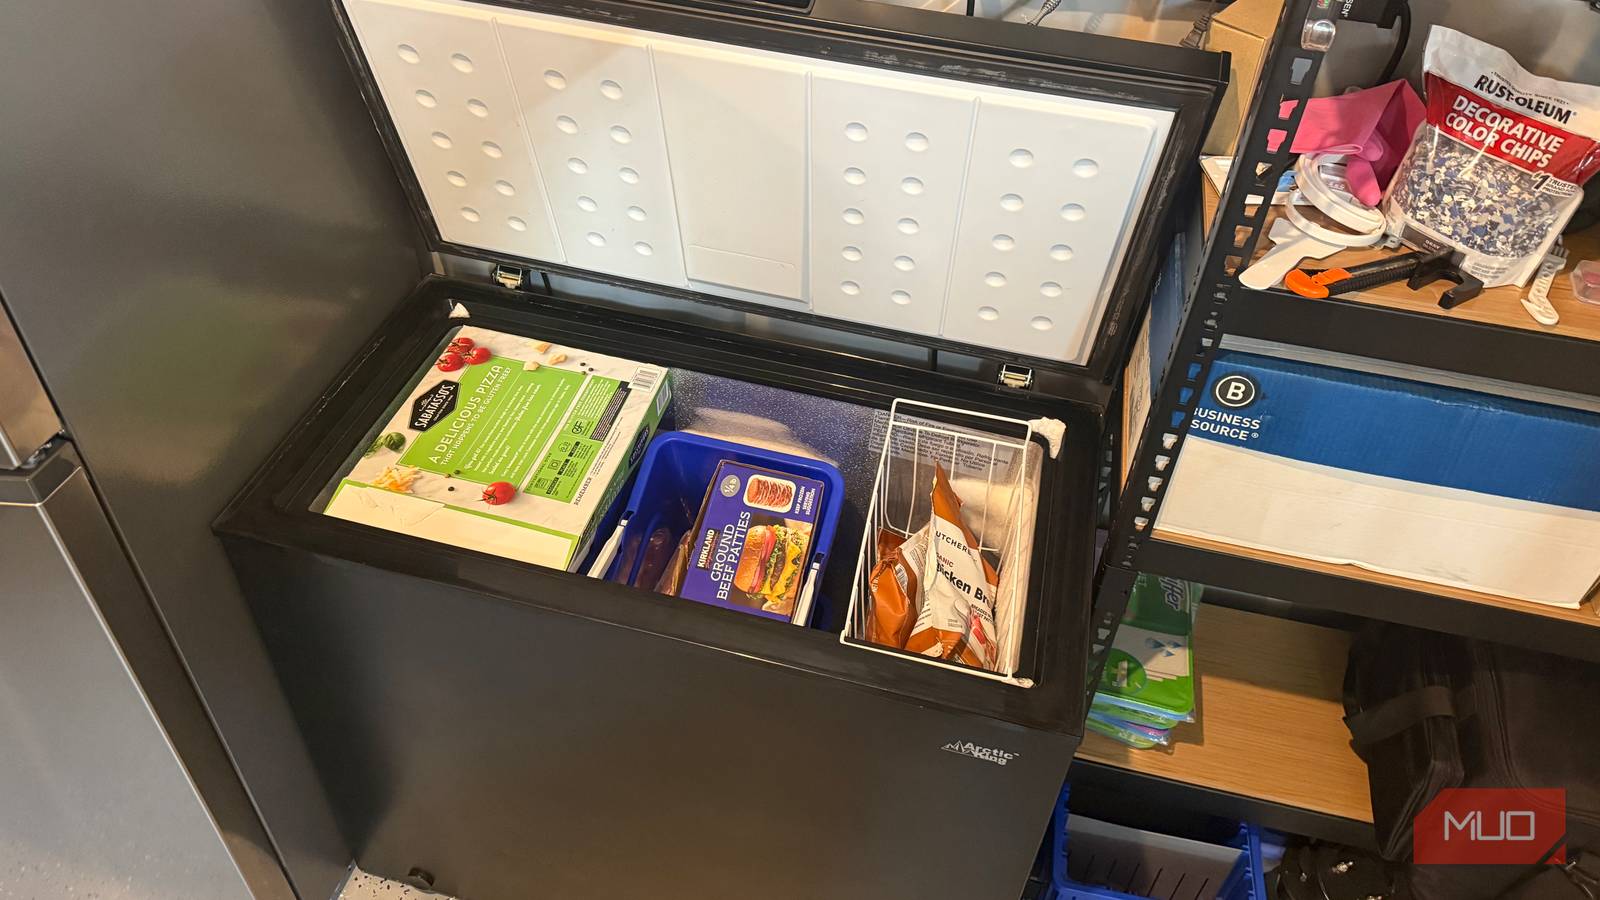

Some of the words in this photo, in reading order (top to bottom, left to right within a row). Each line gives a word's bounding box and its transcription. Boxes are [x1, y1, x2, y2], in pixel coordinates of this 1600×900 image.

[1452, 95, 1565, 153] DECORATIVE
[1474, 74, 1572, 124] RUST-OLEUM
[1445, 112, 1500, 148] COLOR
[1500, 138, 1552, 168] CHIPS
[428, 456, 439, 464] A
[435, 396, 480, 453] DELICIOUS
[476, 365, 504, 394] PIZZA
[1226, 382, 1246, 400] B
[440, 450, 452, 465] THAT
[452, 423, 475, 449] HAPPENS
[472, 414, 480, 424] TO
[484, 382, 502, 404] GLUTEN
[1190, 420, 1250, 440] SOURCE
[698, 529, 715, 568] KIRKLAND
[710, 524, 735, 582] GROUND
[716, 564, 734, 600] BEEF
[729, 511, 751, 564] PATTIES
[964, 742, 1014, 760] Arctic
[973, 752, 1008, 766] King
